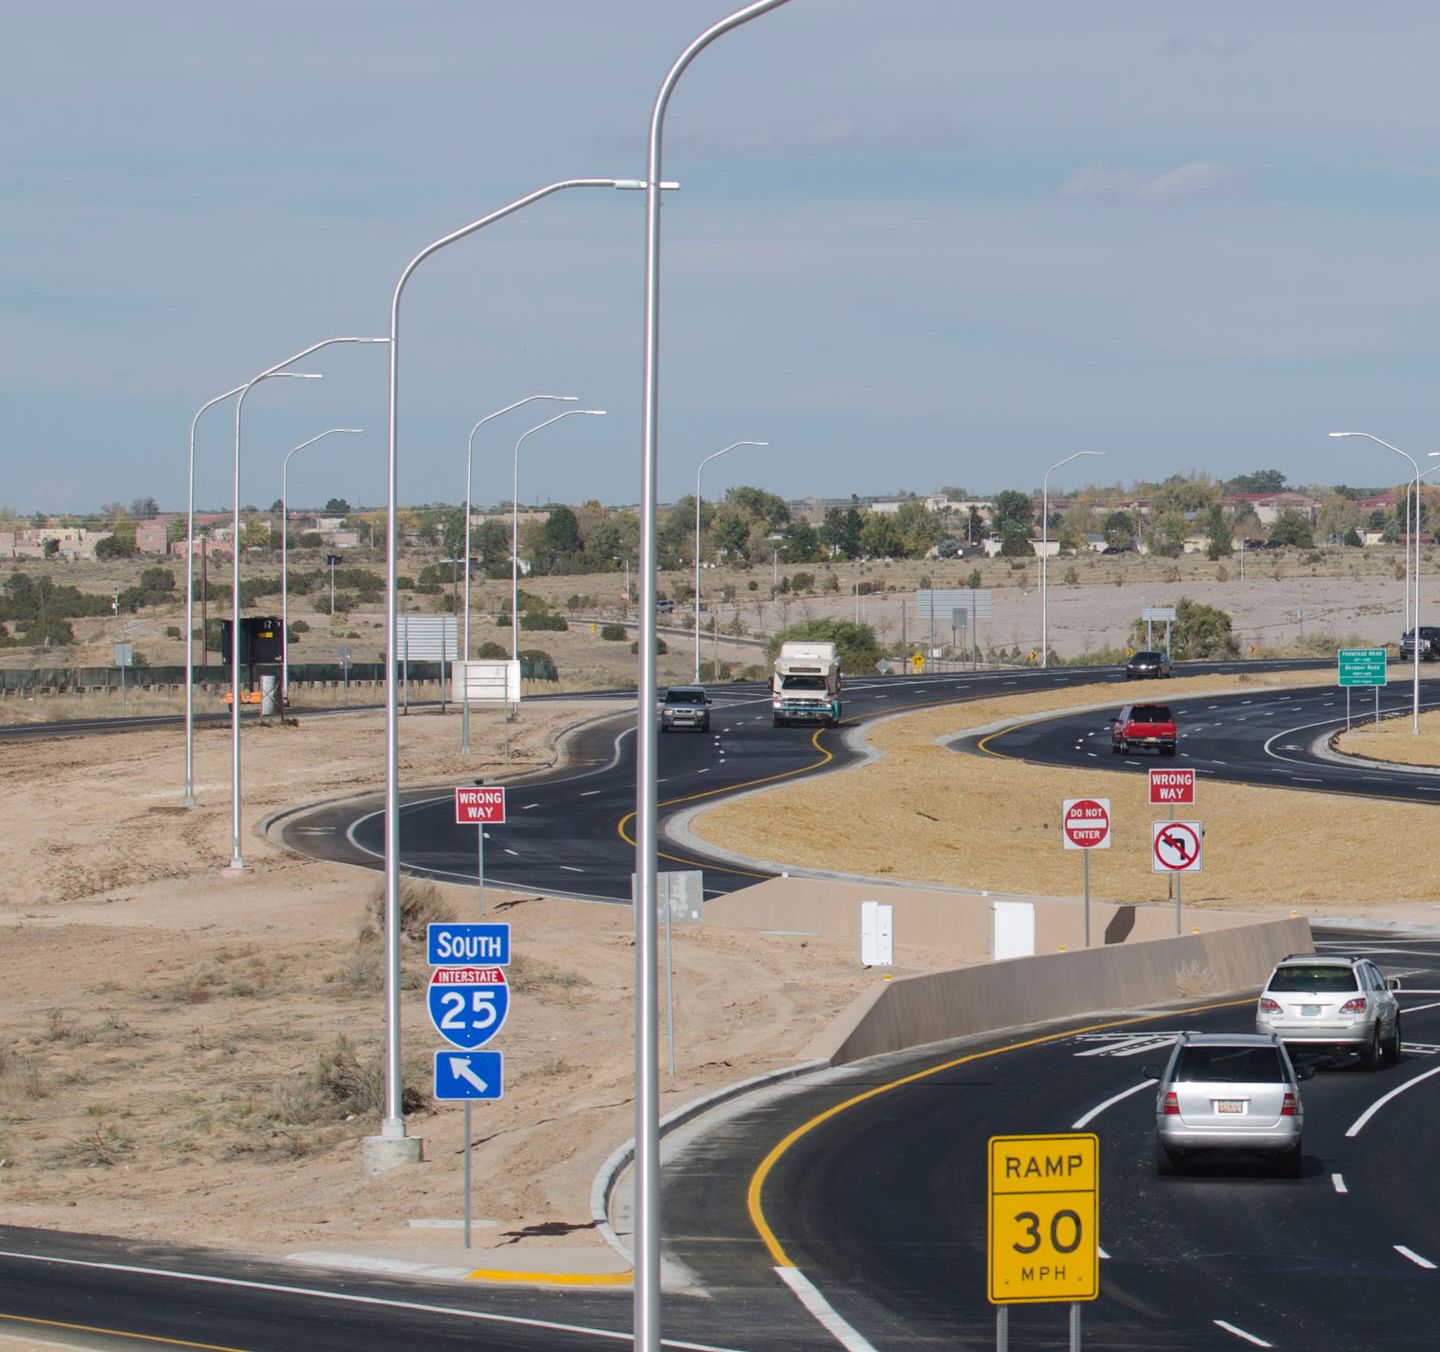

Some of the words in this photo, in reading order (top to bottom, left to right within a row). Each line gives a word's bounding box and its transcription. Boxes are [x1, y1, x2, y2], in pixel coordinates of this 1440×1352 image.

[1152, 774, 1192, 785] WRONG
[459, 792, 502, 804] WRONG
[1160, 788, 1184, 799] WAY
[467, 806, 494, 818] WAY
[1071, 808, 1082, 817] DO
[1085, 808, 1102, 817] NOT
[1072, 830, 1101, 840] ENTER
[436, 931, 502, 958] SOUTH
[438, 970, 499, 983] INTERSTATE
[440, 991, 497, 1030] 25
[1005, 1155, 1083, 1178] RAMP
[1012, 1209, 1082, 1254] 30
[1021, 1265, 1066, 1281] MPH
